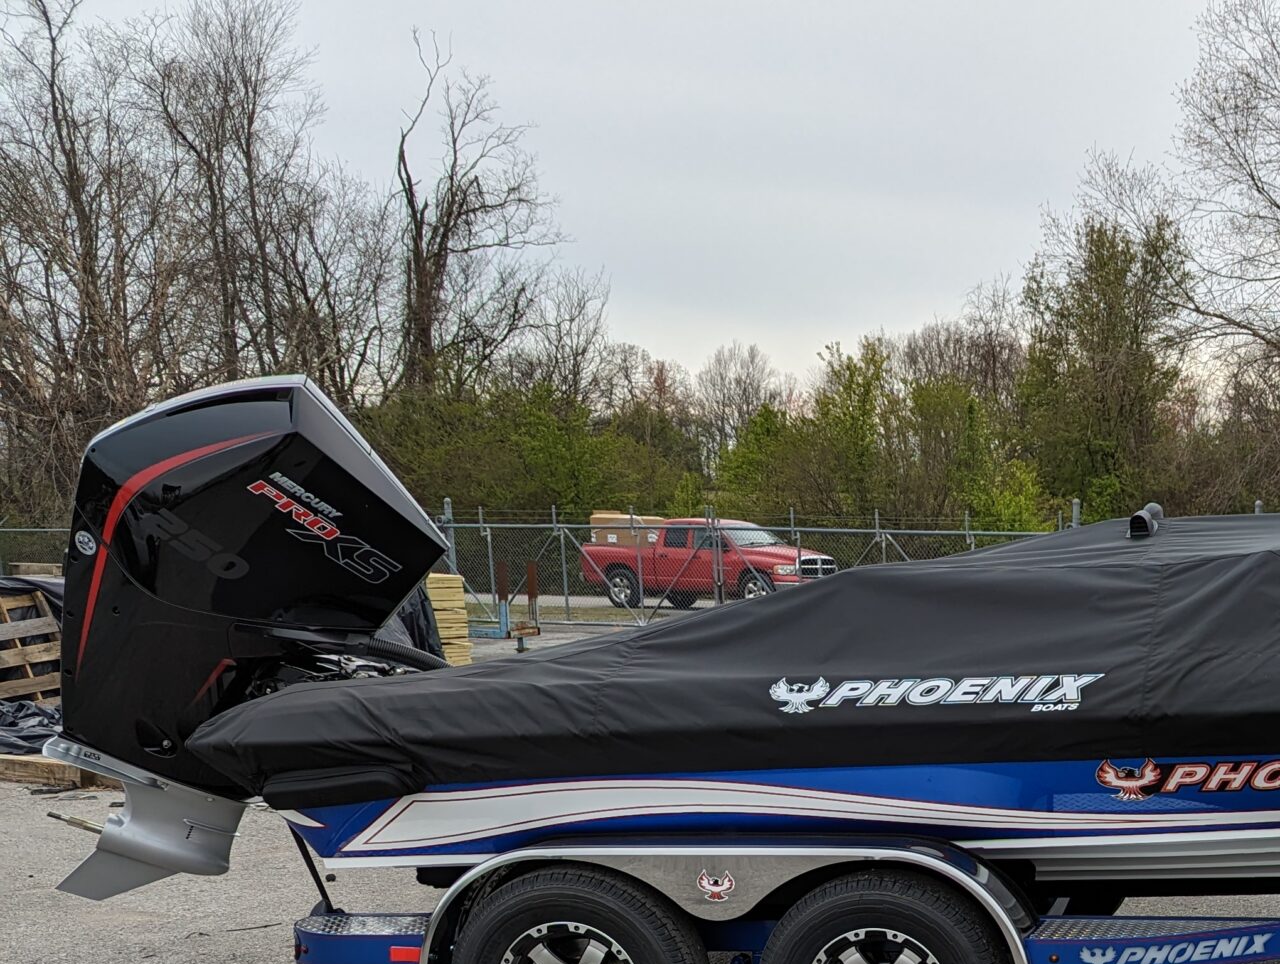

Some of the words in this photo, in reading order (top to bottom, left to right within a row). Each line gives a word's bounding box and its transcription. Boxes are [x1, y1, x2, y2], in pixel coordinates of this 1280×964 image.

[246, 480, 340, 540] PRO
[268, 471, 343, 518] MERCURY
[142, 507, 250, 579] 250
[285, 522, 403, 584] XS
[819, 673, 1105, 707] PHOENIX
[1030, 703, 1079, 712] BOATS
